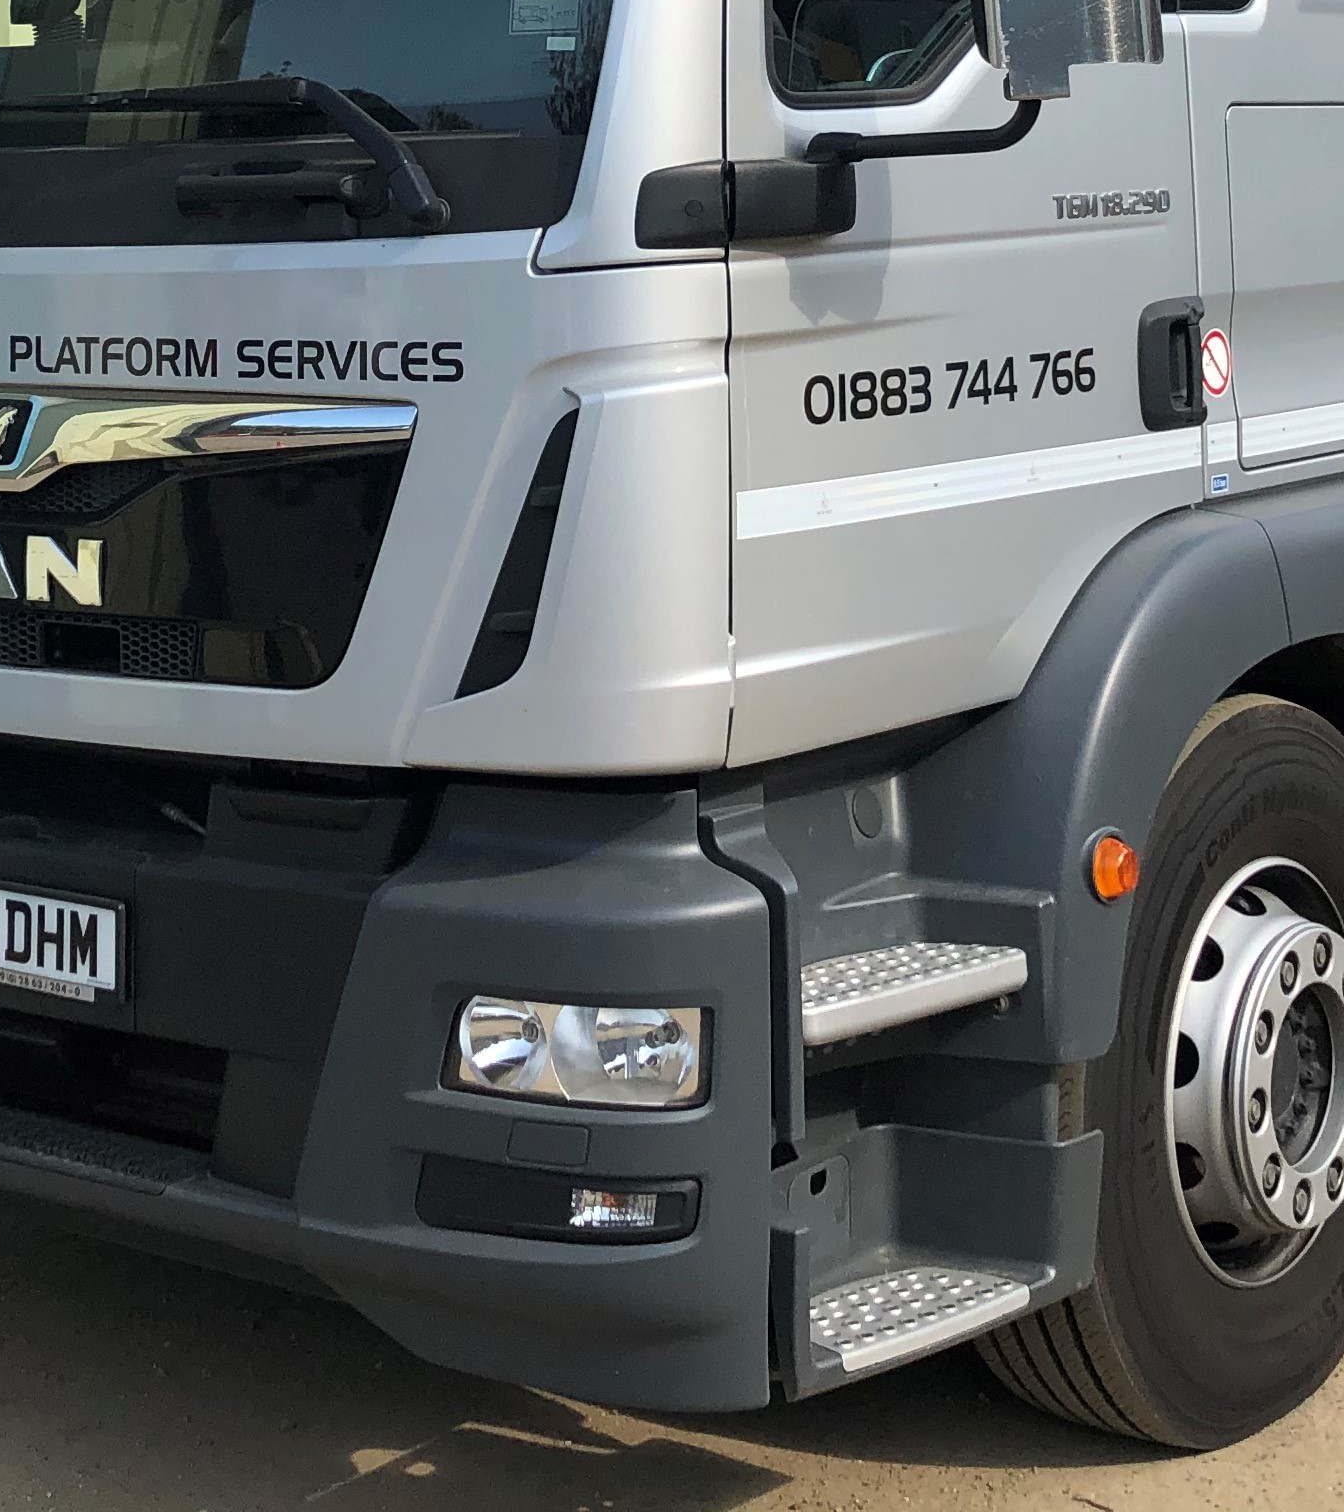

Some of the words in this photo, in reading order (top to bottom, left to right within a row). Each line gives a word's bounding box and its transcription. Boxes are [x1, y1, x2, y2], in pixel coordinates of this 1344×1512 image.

[9, 334, 218, 378] PLATFORM
[236, 338, 465, 383] SERVICES
[803, 365, 932, 426] 01883
[945, 356, 1018, 410] 744
[1029, 347, 1096, 400] 766
[4, 898, 98, 978] DHM
